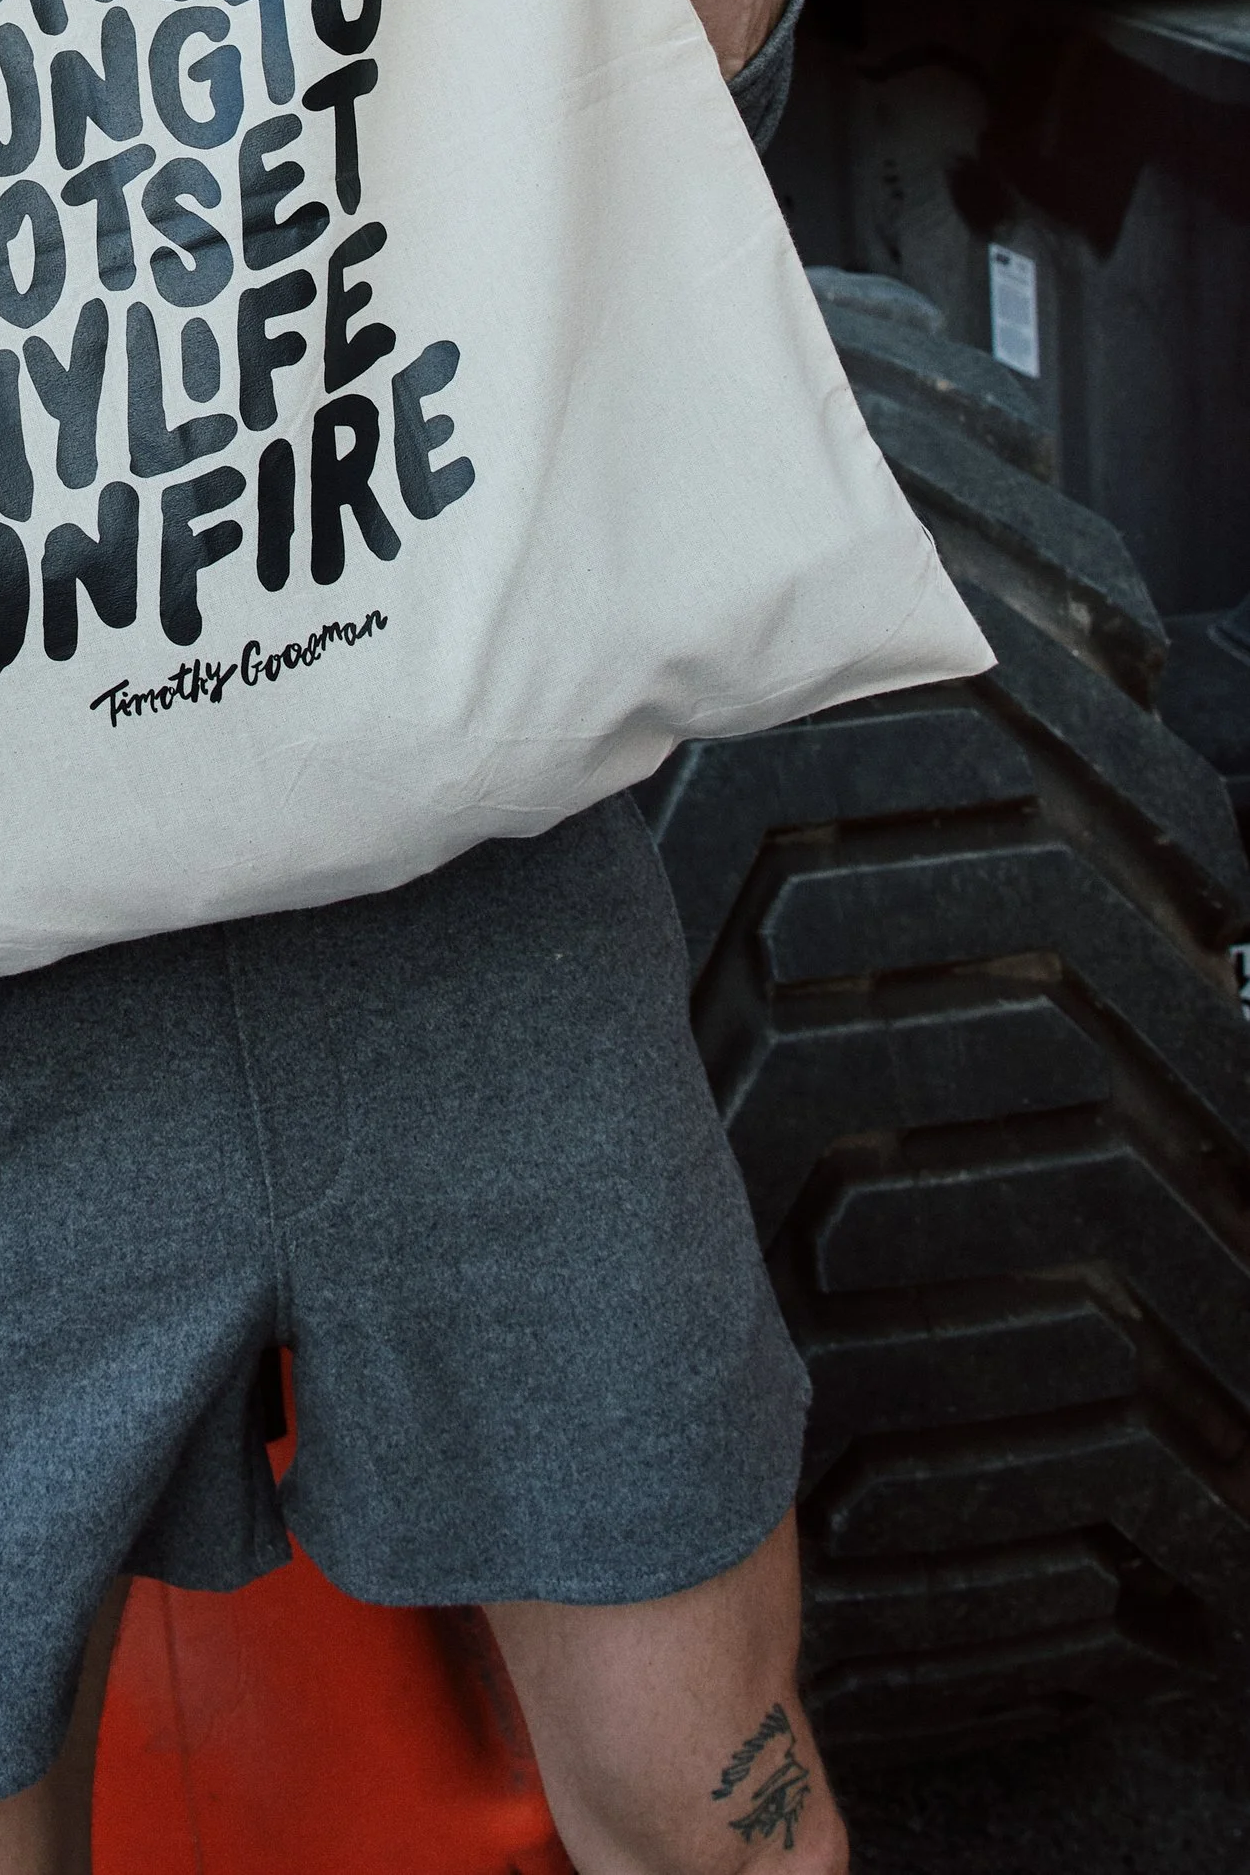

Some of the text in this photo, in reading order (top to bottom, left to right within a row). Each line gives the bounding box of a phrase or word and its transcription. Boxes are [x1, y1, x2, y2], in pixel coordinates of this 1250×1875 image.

[140, 57, 379, 308] SET
[125, 221, 397, 479] LIFE
[158, 339, 476, 647] FIRE
[90, 609, 389, 728] Timothy Goodman
